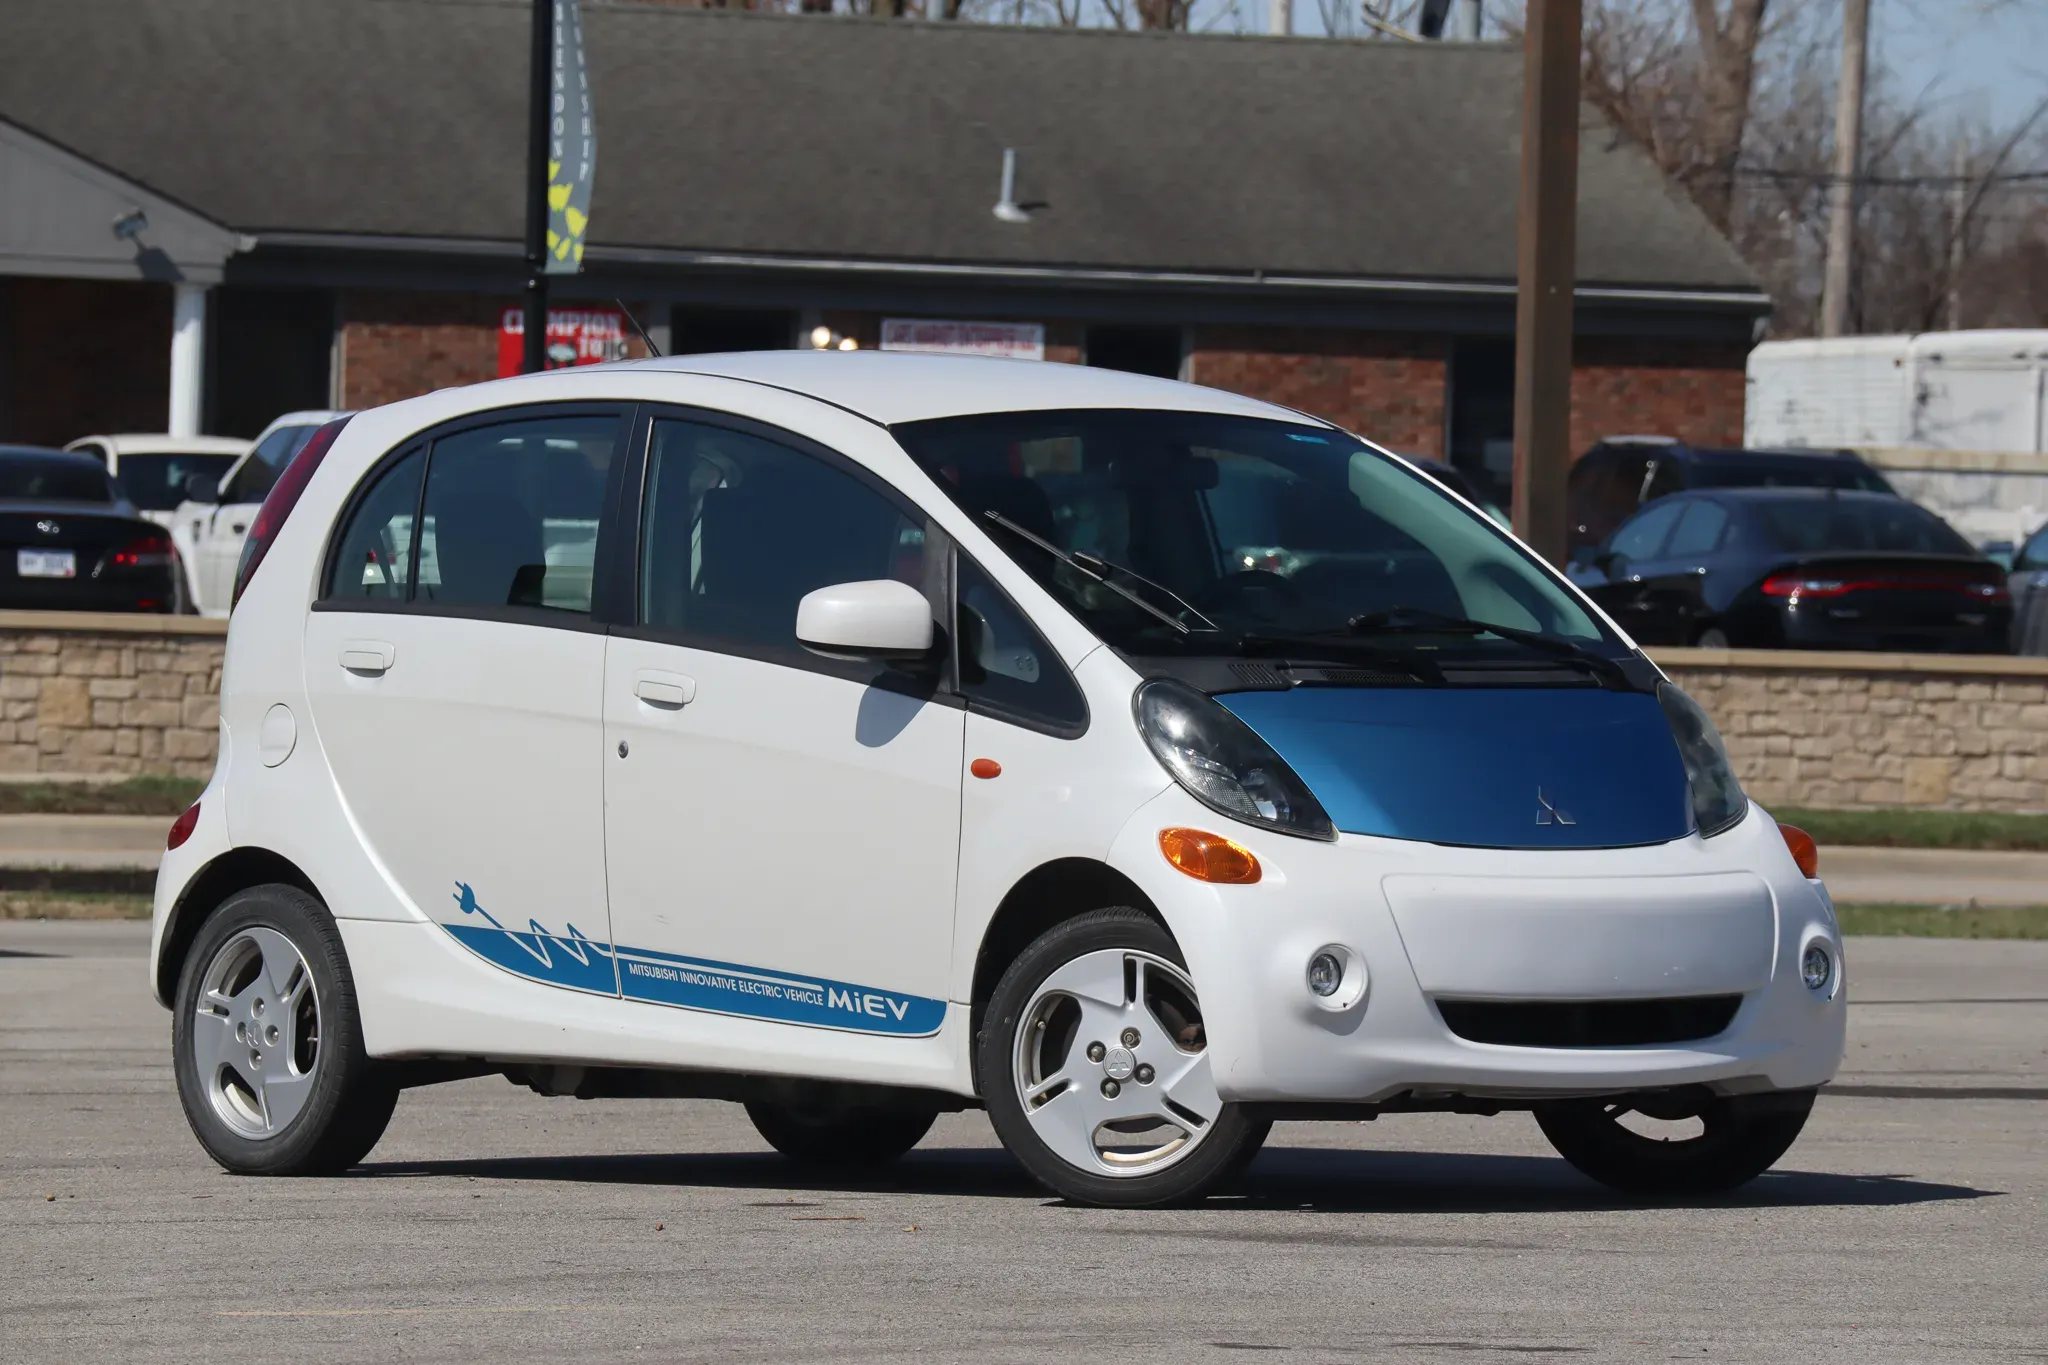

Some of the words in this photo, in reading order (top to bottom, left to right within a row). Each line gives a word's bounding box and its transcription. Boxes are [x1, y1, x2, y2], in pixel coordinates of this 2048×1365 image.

[503, 309, 621, 337] CMPION
[628, 962, 679, 982] MITSUBISHI
[680, 971, 737, 992] INNOVATIVE
[738, 980, 782, 998] ELECTRIC
[782, 988, 824, 1006] VEHICLE
[828, 987, 910, 1021] MiEV
